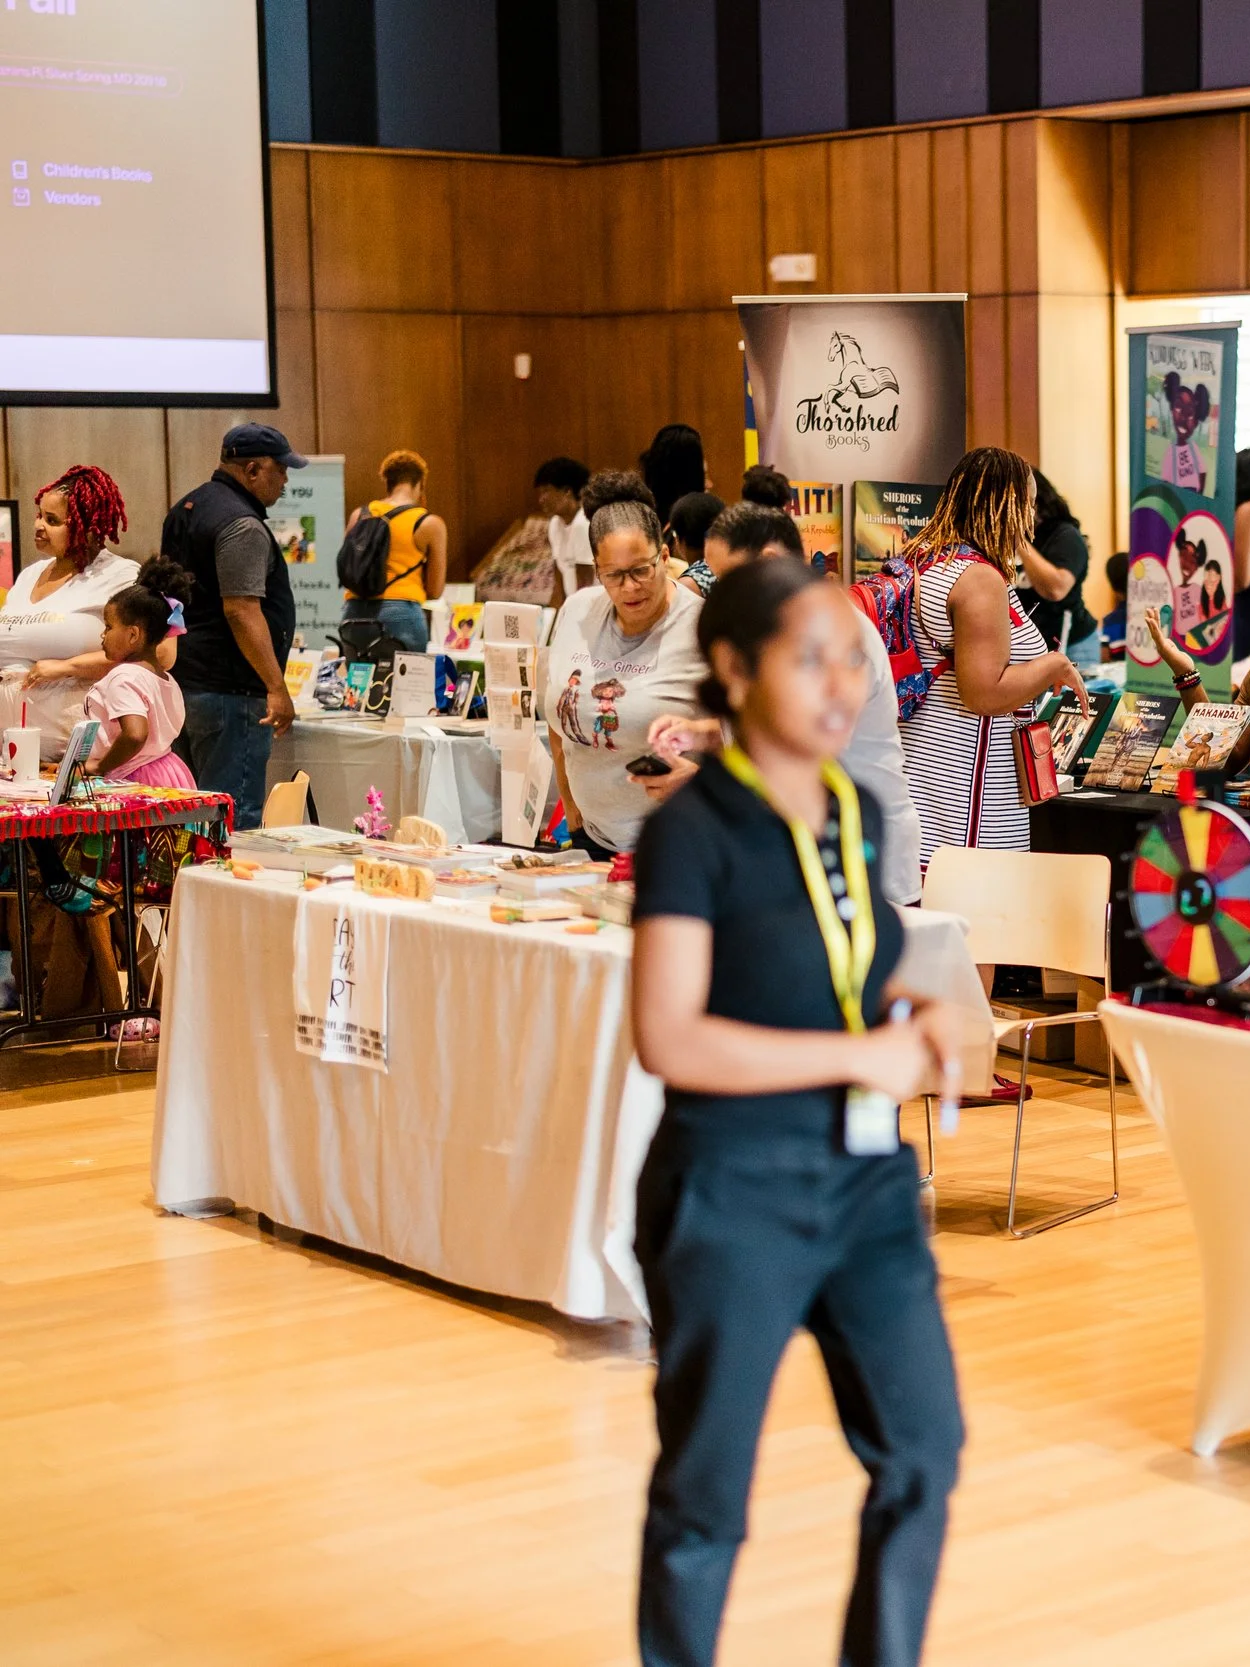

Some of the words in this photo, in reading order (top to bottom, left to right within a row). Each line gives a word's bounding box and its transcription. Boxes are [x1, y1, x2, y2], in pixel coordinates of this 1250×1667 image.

[43, 162, 110, 181] Children's
[111, 166, 153, 183] Books
[44, 189, 102, 206] Vendors
[796, 393, 900, 432] Thorobred
[825, 432, 871, 452] Books
[291, 486, 314, 499] YOU
[883, 491, 922, 505] SHEROES
[784, 487, 834, 516] AITI
[866, 514, 897, 526] Haitian
[897, 516, 930, 528] Revoluti
[1192, 708, 1239, 720] MAKANDAL
